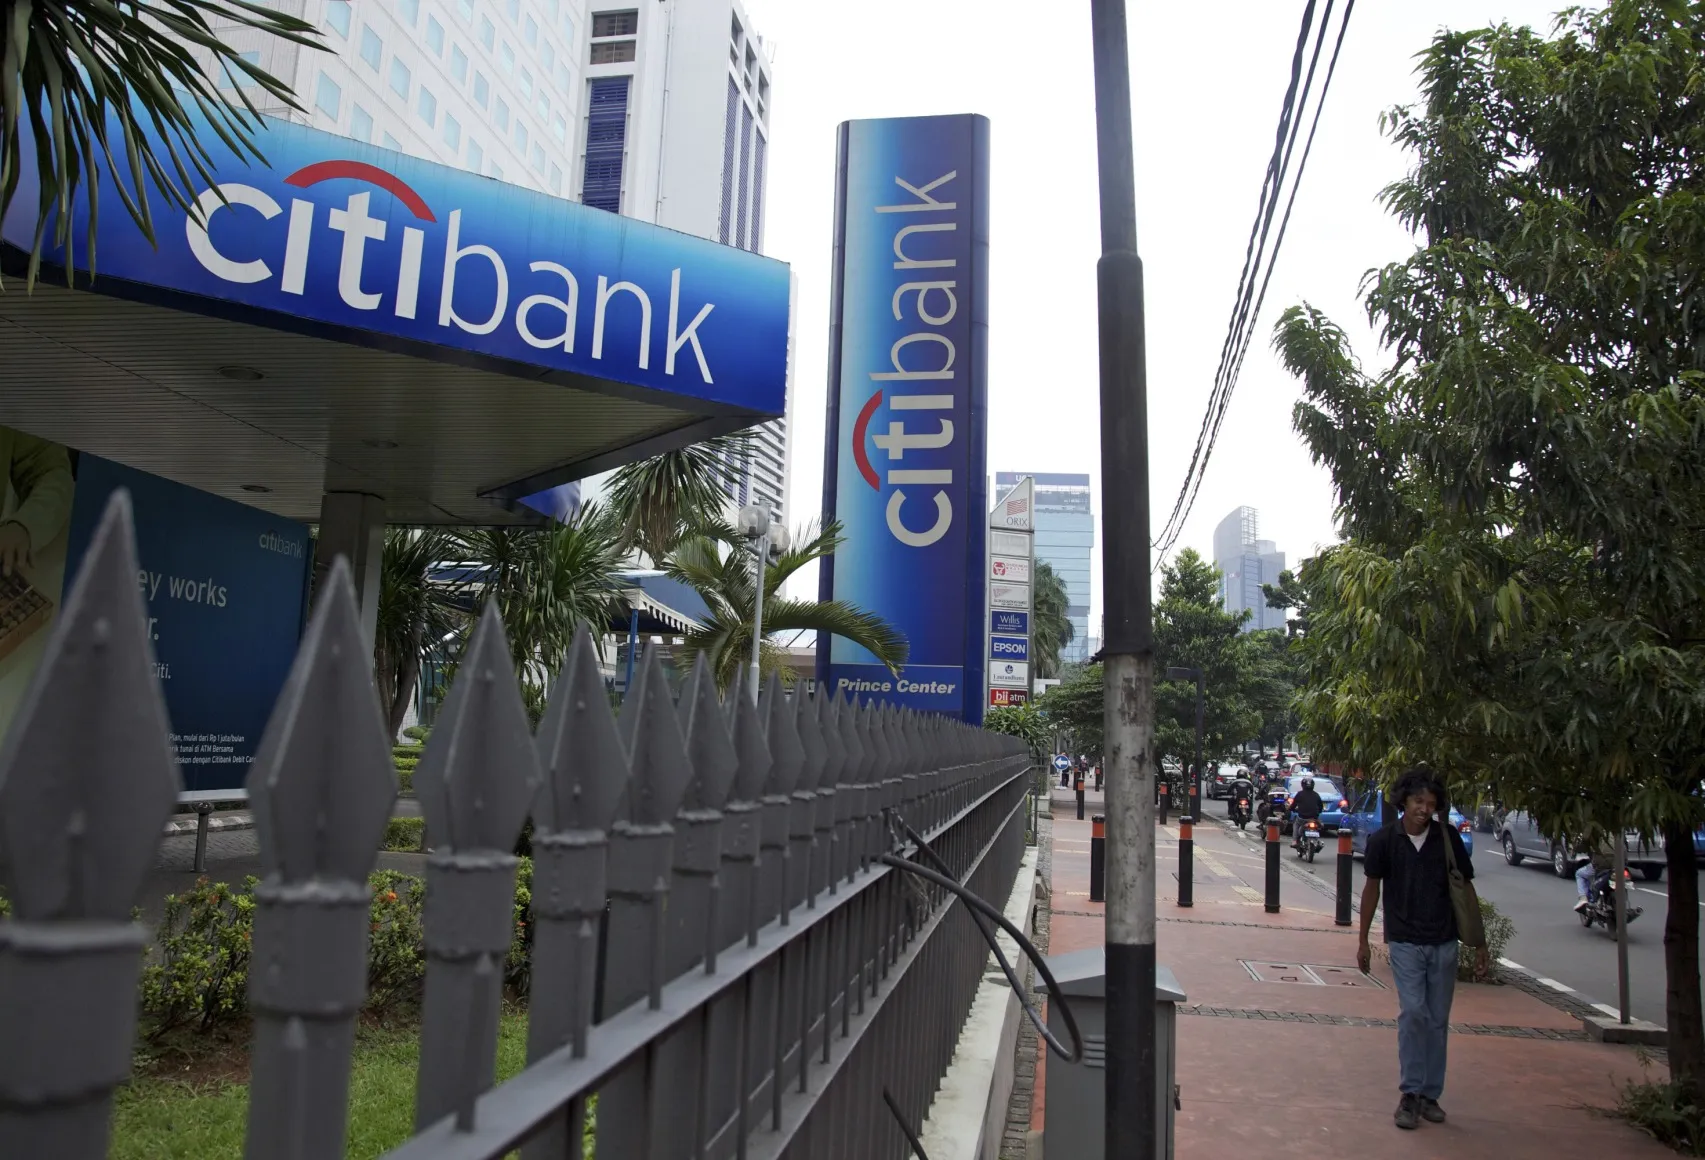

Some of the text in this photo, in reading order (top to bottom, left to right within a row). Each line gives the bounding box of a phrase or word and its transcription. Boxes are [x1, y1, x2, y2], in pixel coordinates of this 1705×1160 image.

[186, 183, 715, 385] citibank
[868, 170, 957, 548] citibank
[1006, 516, 1028, 527] ORIX
[258, 532, 303, 558] citibank
[169, 575, 227, 607] works
[1000, 614, 1020, 625] Willis
[993, 642, 1026, 654] EPSON
[837, 678, 956, 694] Prince Center
[996, 690, 1009, 701] bii
[1009, 694, 1026, 702] atm
[198, 734, 209, 742] dari
[209, 734, 217, 743] Rp
[194, 745, 200, 753] di
[200, 744, 212, 753] ATM
[212, 745, 234, 753] Bersama
[192, 756, 211, 765] dengan
[211, 756, 232, 764] Citibank
